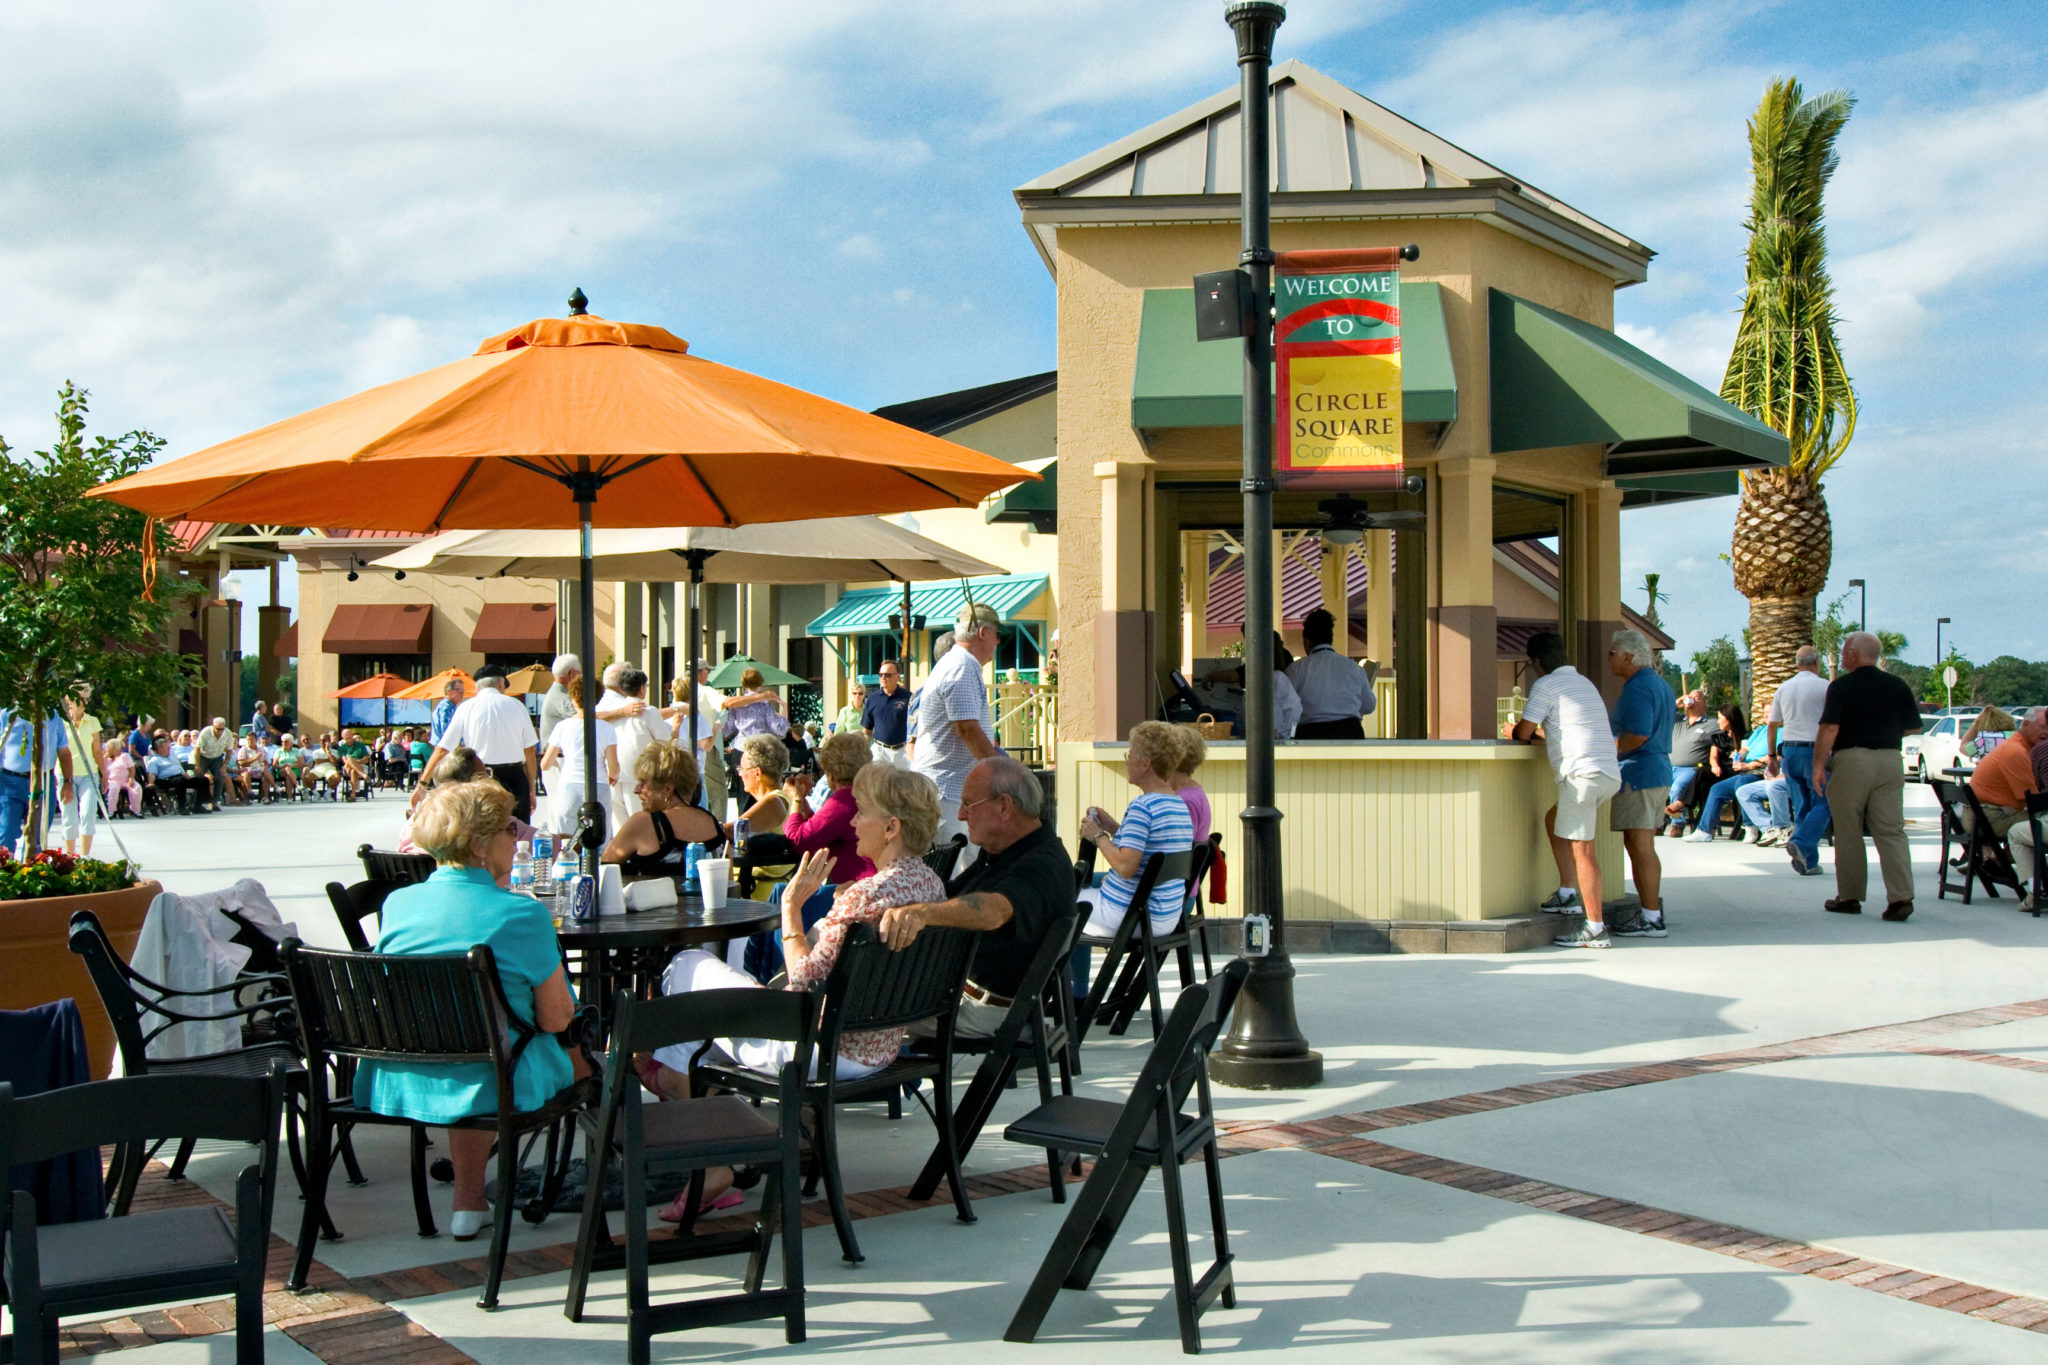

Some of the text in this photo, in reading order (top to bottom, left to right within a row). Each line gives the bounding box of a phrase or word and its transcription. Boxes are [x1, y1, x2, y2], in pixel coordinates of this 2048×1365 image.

[1284, 277, 1391, 296] WELCOME
[1323, 319, 1354, 335] TO
[1295, 392, 1388, 412] CIRCLE
[1295, 418, 1394, 440] SQUARE
[1295, 443, 1394, 460] Commons
